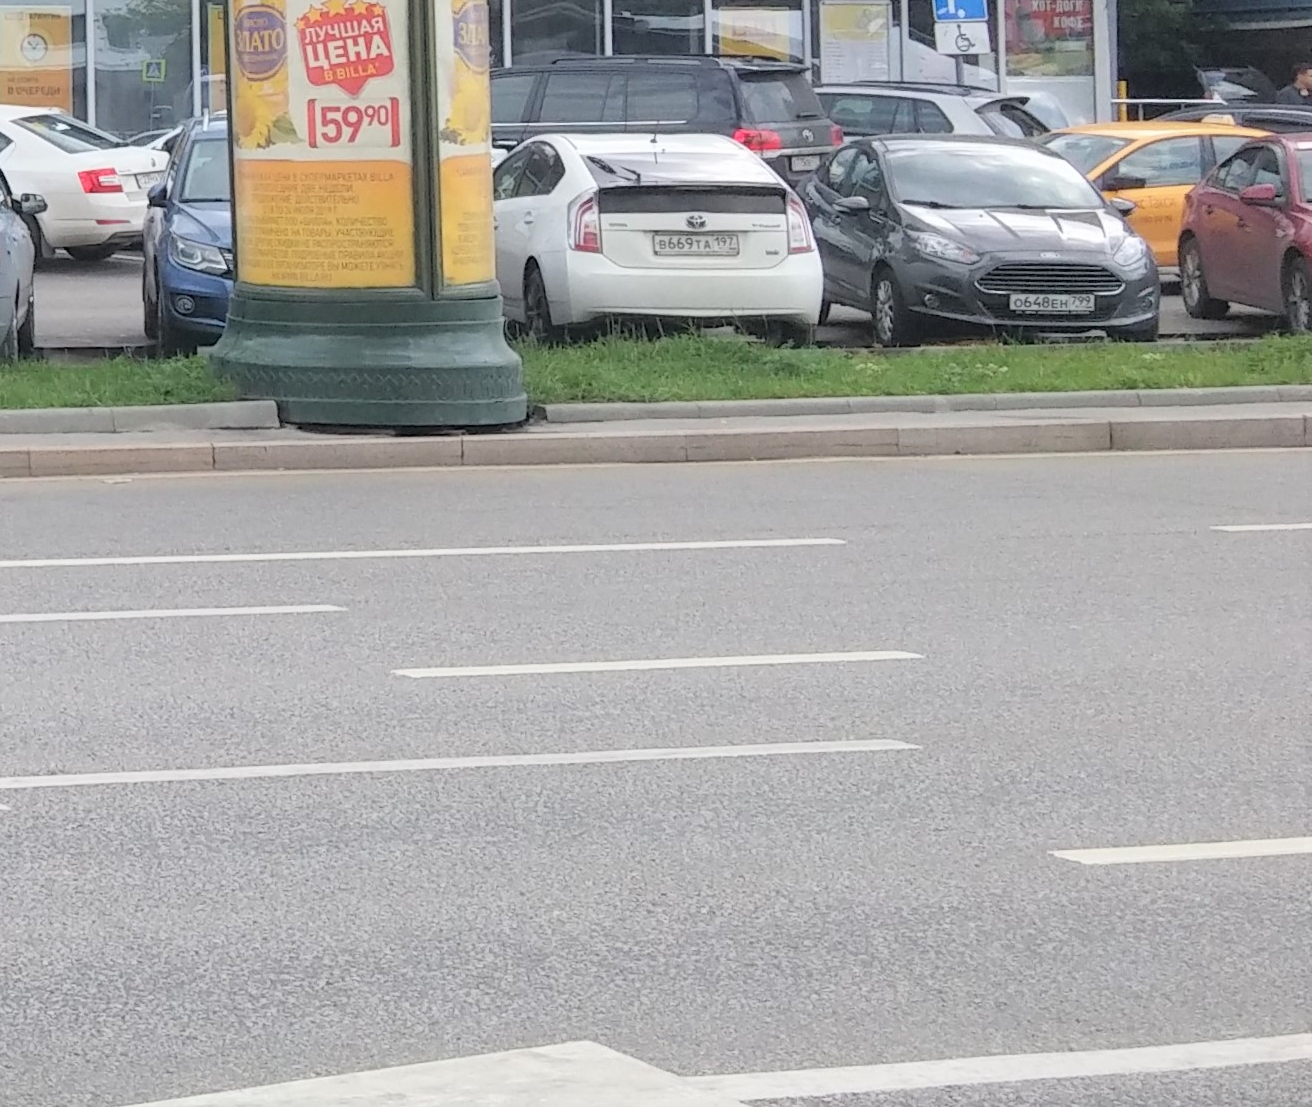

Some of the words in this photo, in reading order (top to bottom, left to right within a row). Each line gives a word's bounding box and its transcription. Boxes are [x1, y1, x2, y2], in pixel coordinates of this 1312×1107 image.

[1031, 0, 1084, 13] ХОТ-ДОГИ
[304, 16, 384, 44] ЛУЧШАЯ
[1053, 16, 1084, 29] КОФЕ
[306, 34, 390, 69] ЦЕНА
